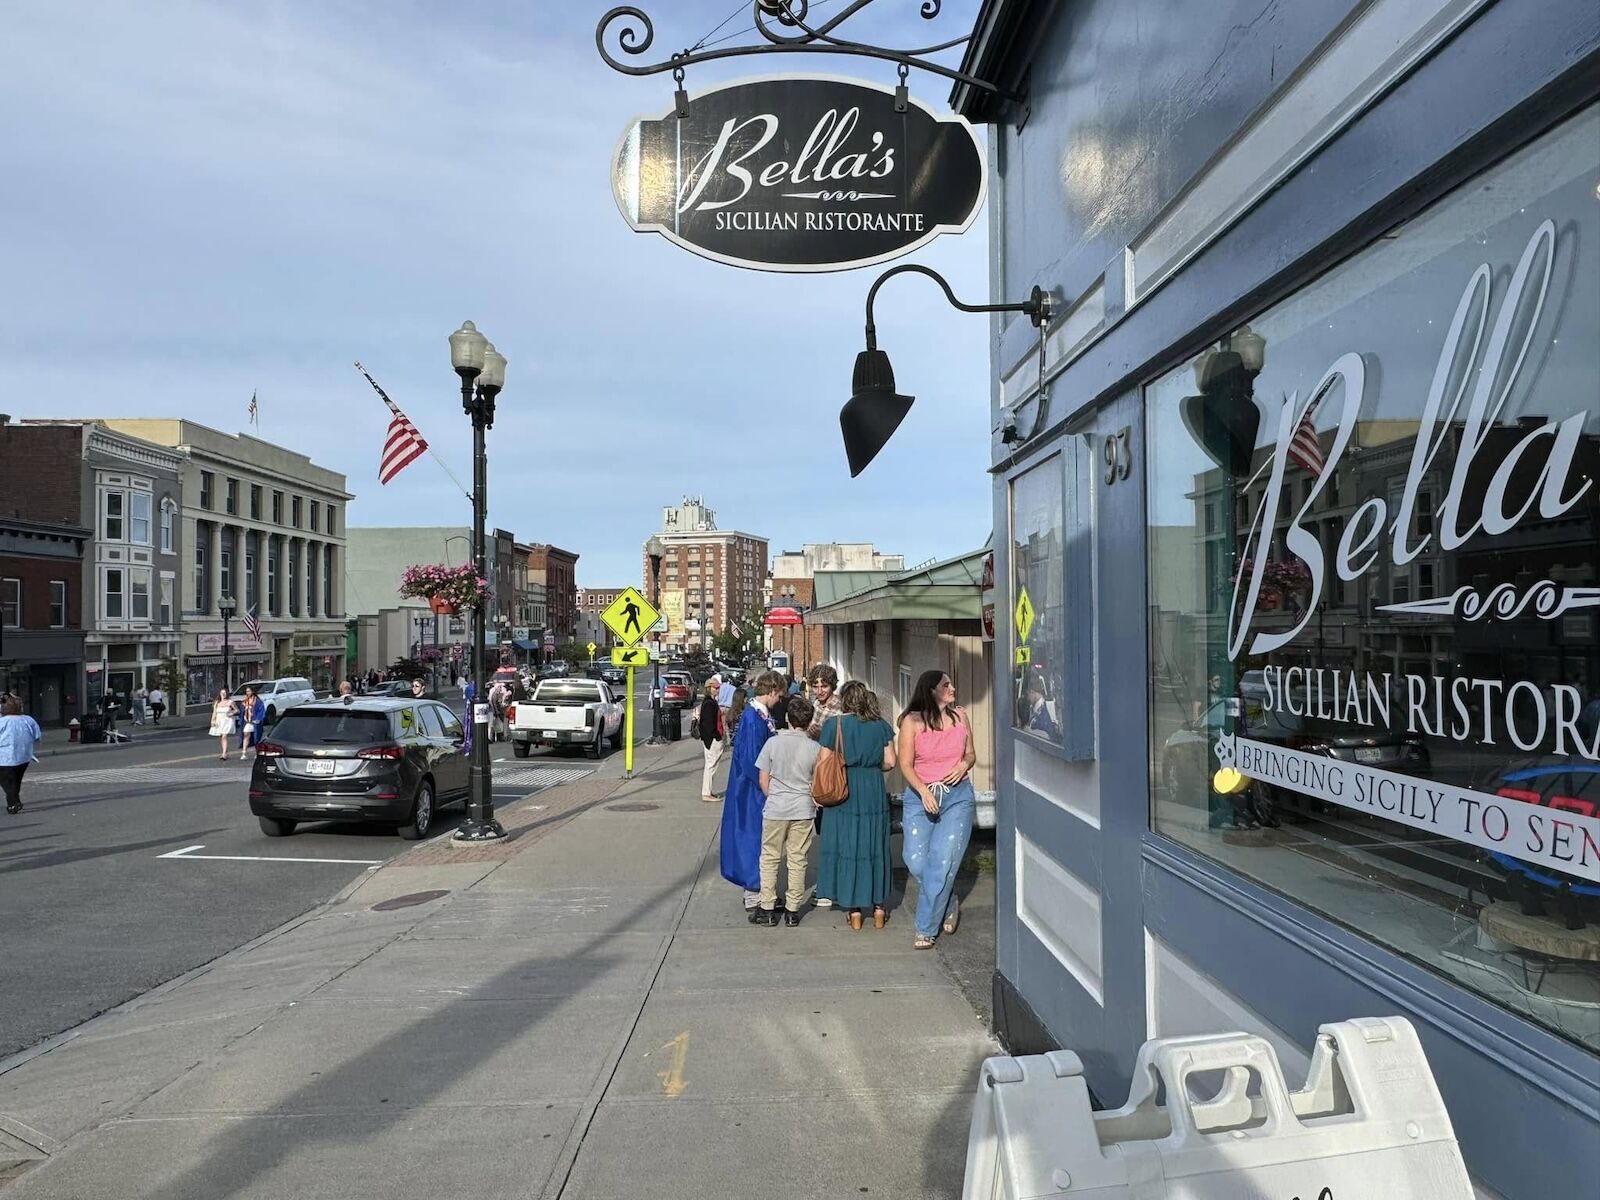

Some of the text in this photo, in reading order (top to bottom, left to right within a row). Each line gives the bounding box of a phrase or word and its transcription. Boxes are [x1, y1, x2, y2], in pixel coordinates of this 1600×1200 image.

[676, 107, 896, 213] Bella's
[715, 211, 924, 232] SICILIAN RISTORANTE
[1104, 425, 1132, 486] 93
[1228, 218, 1592, 662] Bella
[1262, 664, 1600, 760] SICILIAN RISTOR
[1241, 744, 1344, 797] BRINGING
[1353, 772, 1446, 825] SICILY
[1458, 797, 1510, 843] TO
